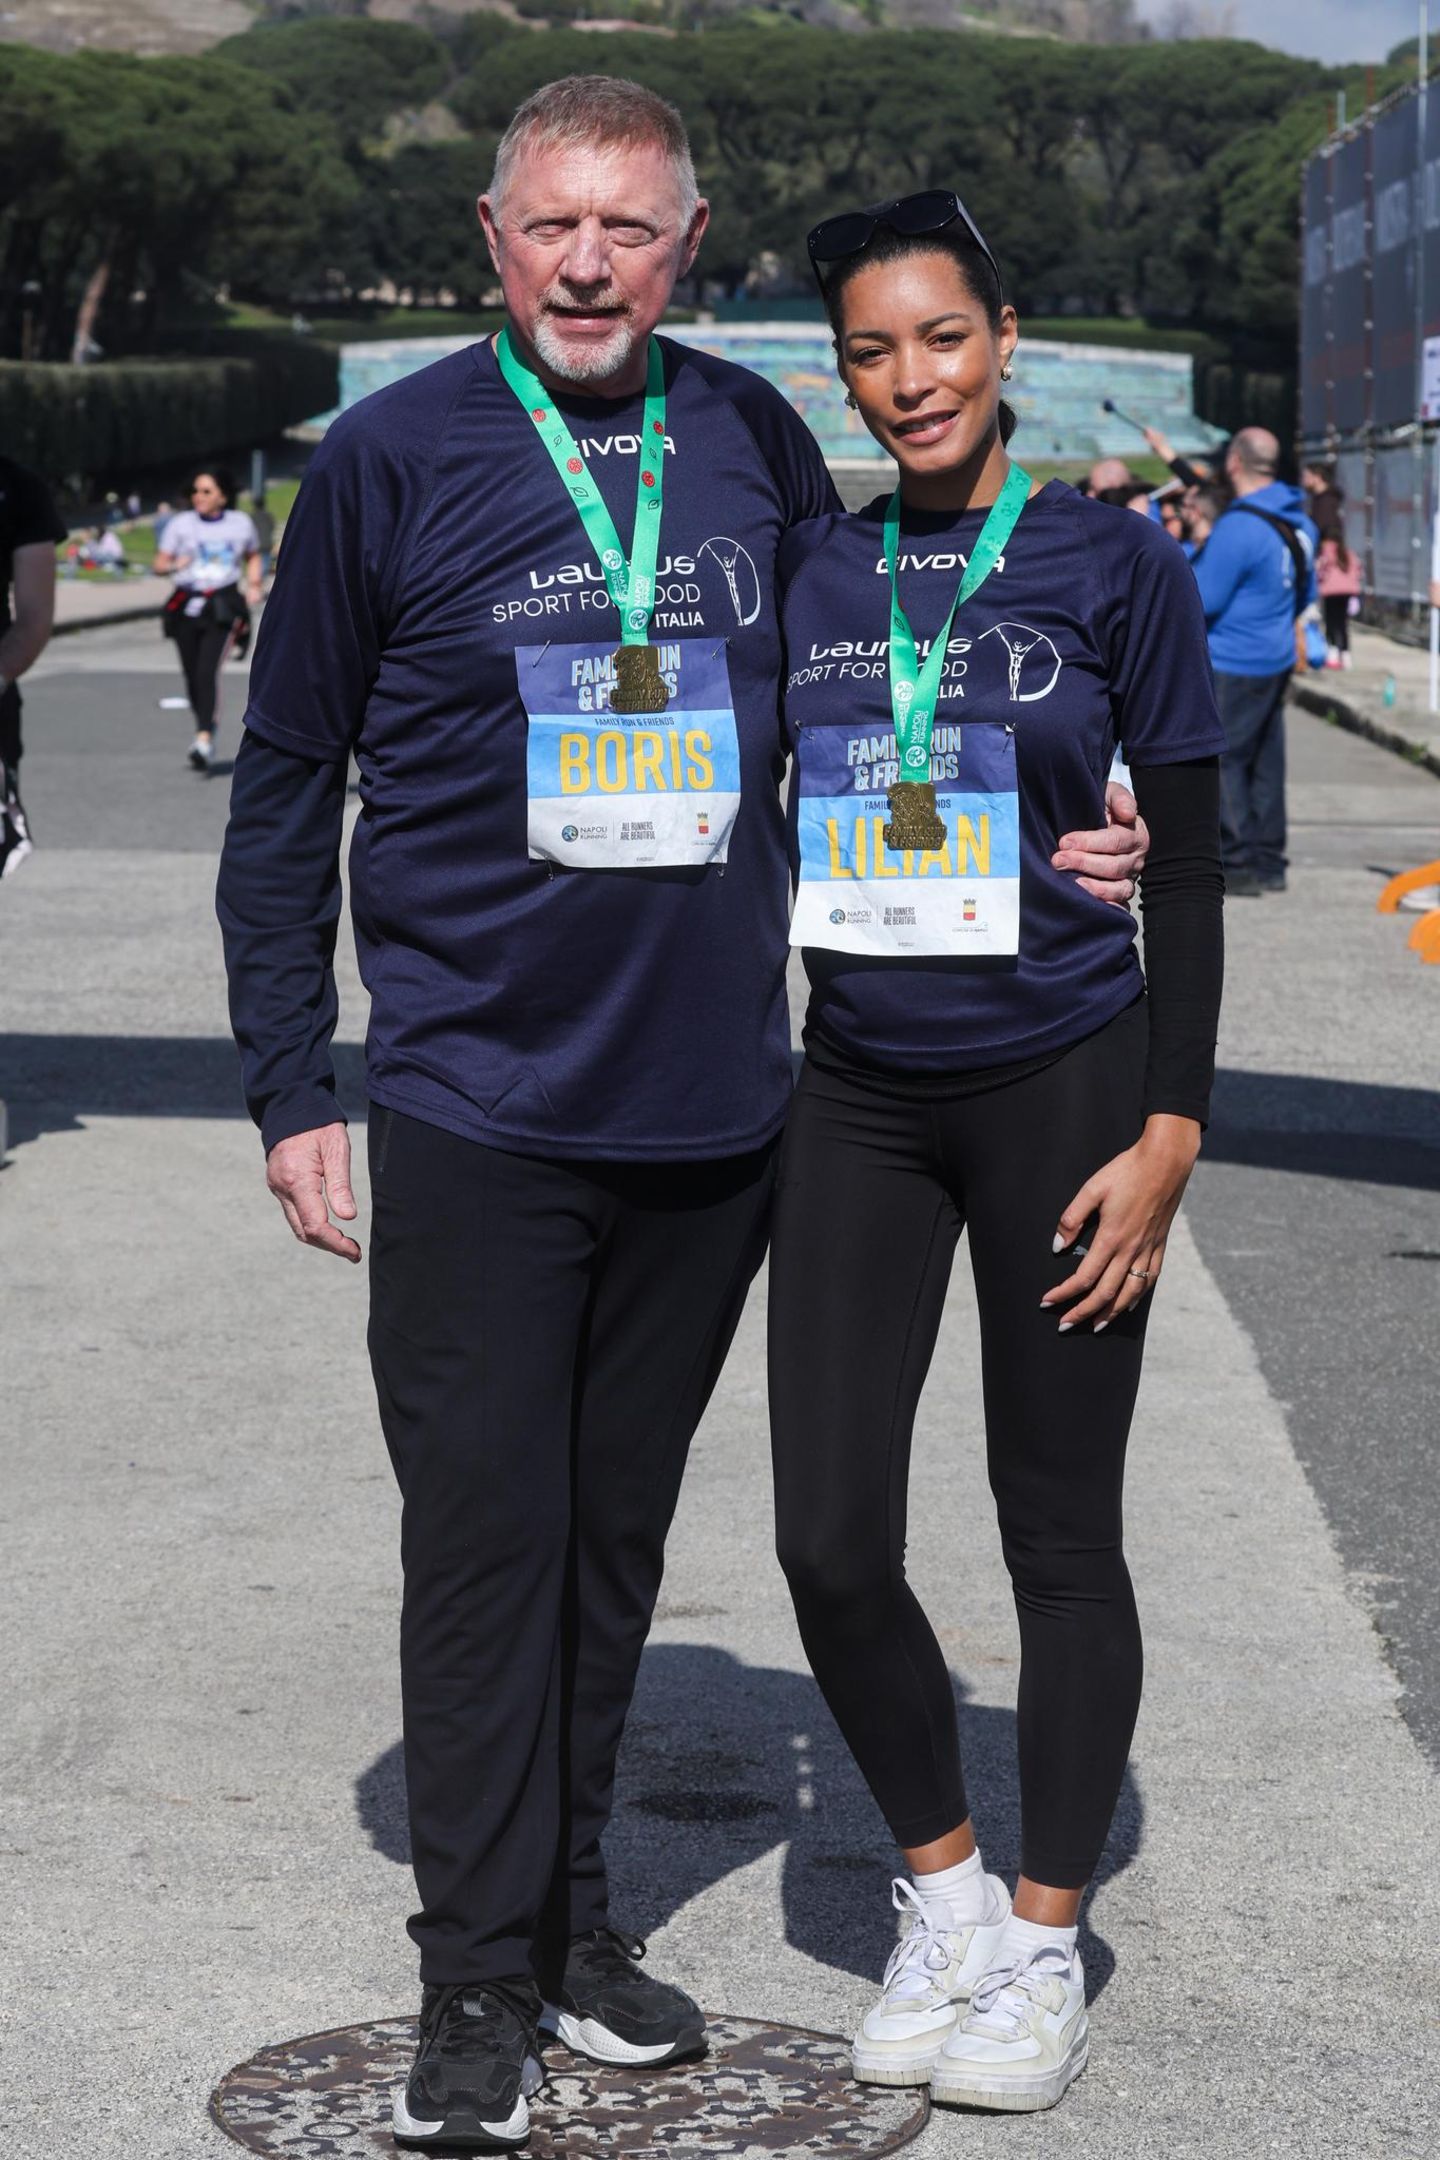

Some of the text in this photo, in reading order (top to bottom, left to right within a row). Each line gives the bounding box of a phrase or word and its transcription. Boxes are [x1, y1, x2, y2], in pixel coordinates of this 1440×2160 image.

[574, 434, 677, 458] IVOA
[529, 555, 695, 590] Lauus
[492, 583, 701, 623] SPORT FO OOD
[655, 611, 704, 629] ITALIA
[657, 643, 681, 673] UN
[786, 662, 886, 694] SPORT FOR
[578, 685, 594, 711] &
[936, 684, 965, 699] LIA
[594, 718, 620, 727] FAMILY
[621, 718, 636, 727] RUN
[644, 716, 675, 726] FRIENDS
[910, 709, 922, 744] NAPOLI
[847, 726, 962, 767] FAMI UN
[558, 729, 715, 795] BORIS
[854, 753, 960, 791] & FRDS
[864, 800, 889, 811] FAMIL
[580, 825, 608, 834] NAPOLI
[620, 830, 655, 841] ARE BEAUTIFUL
[631, 821, 653, 830] RUNNERS
[847, 910, 872, 918] NAPOLI
[883, 915, 917, 926] ARE BEAUTIFUL
[884, 906, 915, 916] ALL RUNNERS
